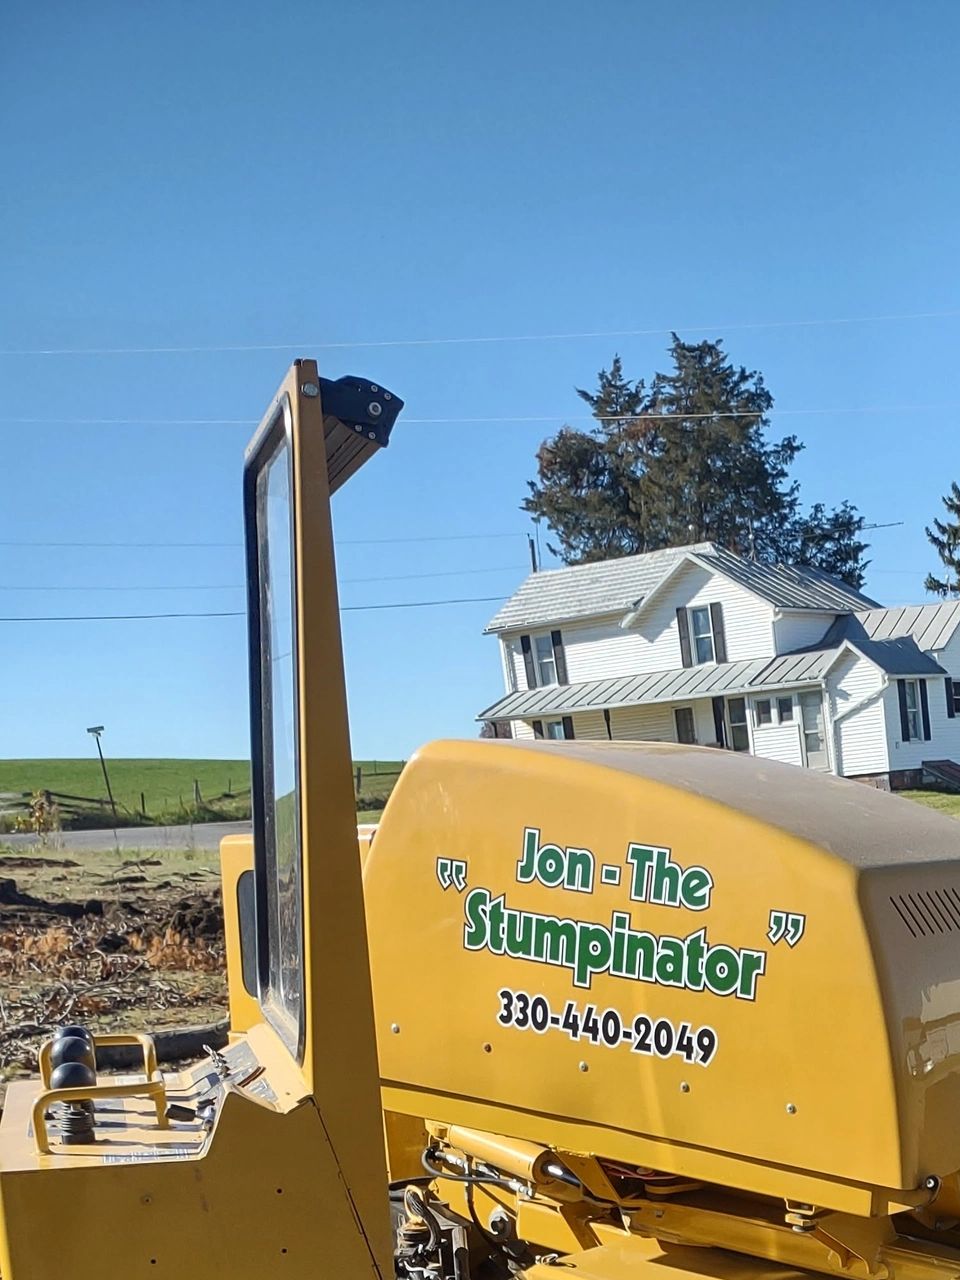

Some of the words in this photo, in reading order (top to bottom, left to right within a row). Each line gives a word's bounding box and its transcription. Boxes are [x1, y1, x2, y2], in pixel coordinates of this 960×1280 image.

[517, 827, 594, 894] Jon
[627, 842, 713, 911] The
[464, 887, 766, 1001] Stumpinator
[497, 990, 718, 1067] 330-440-2049
